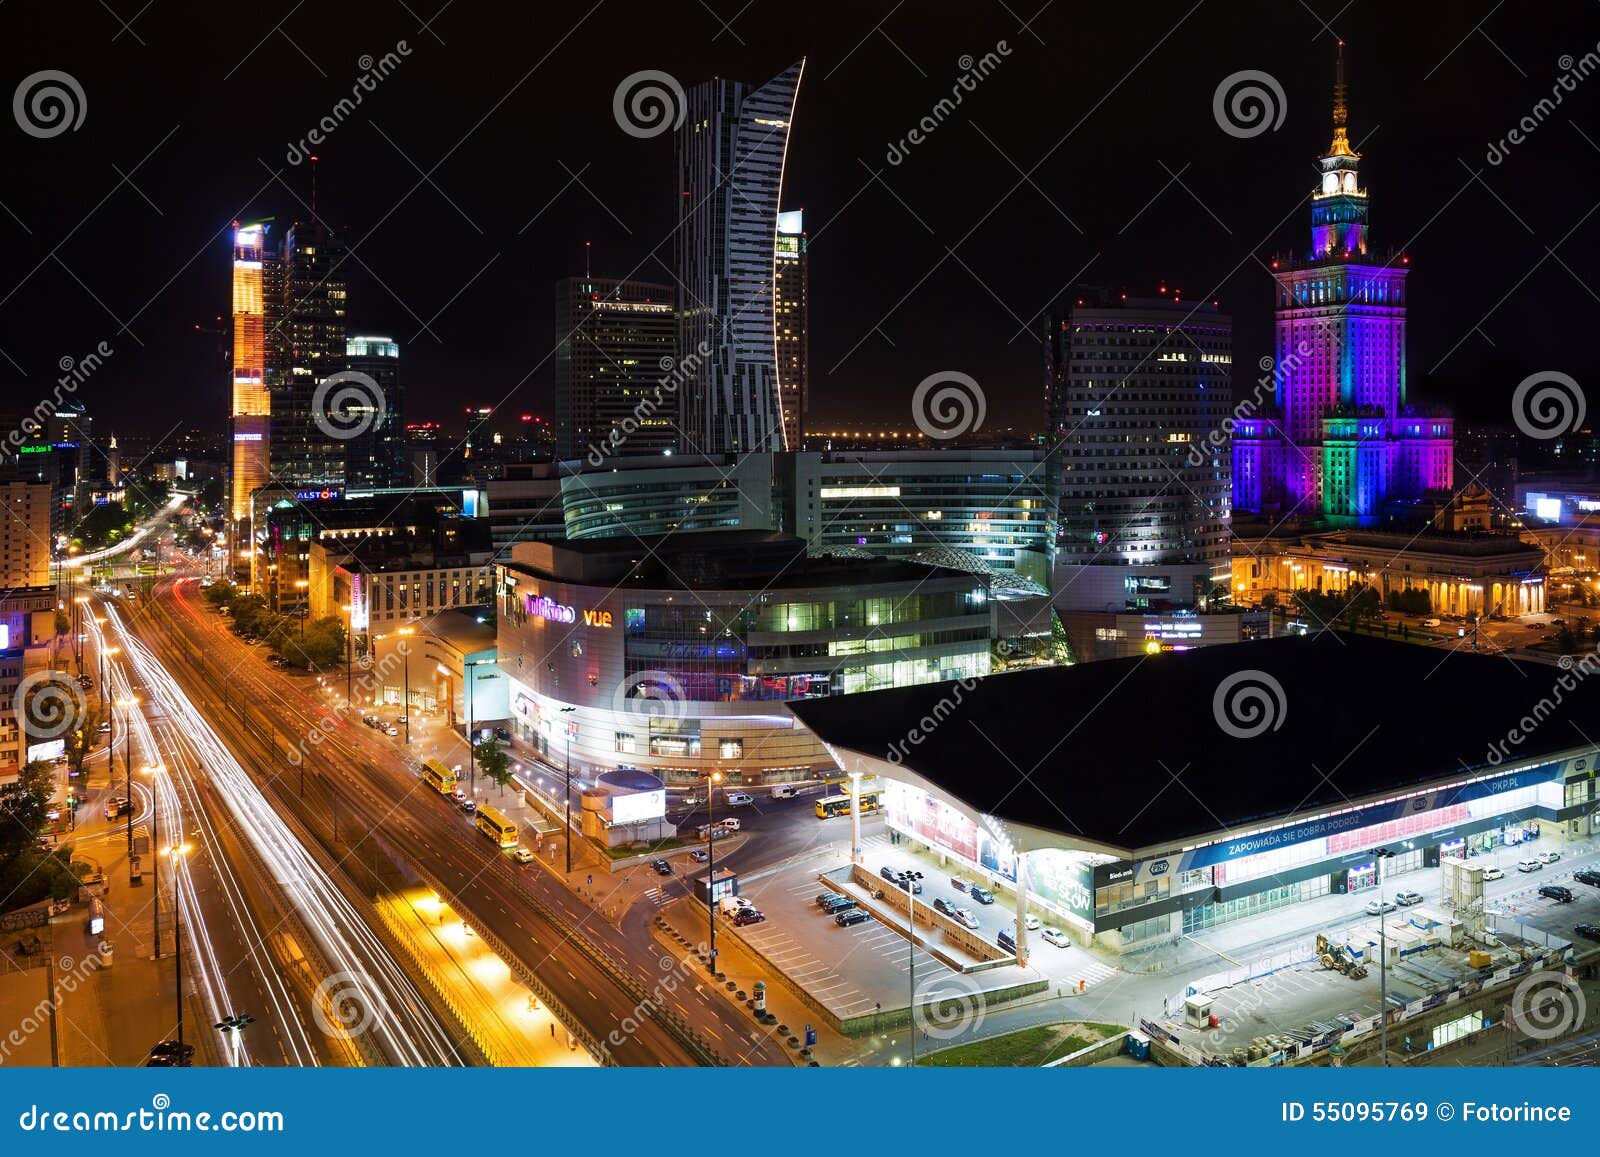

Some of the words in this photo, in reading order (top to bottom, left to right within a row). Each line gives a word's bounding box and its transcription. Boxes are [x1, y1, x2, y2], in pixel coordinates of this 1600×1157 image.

[297, 488, 338, 499] ALSTOM
[584, 609, 612, 628] vue
[1492, 778, 1519, 792] PKP.PL
[1298, 823, 1326, 838] DOBRA
